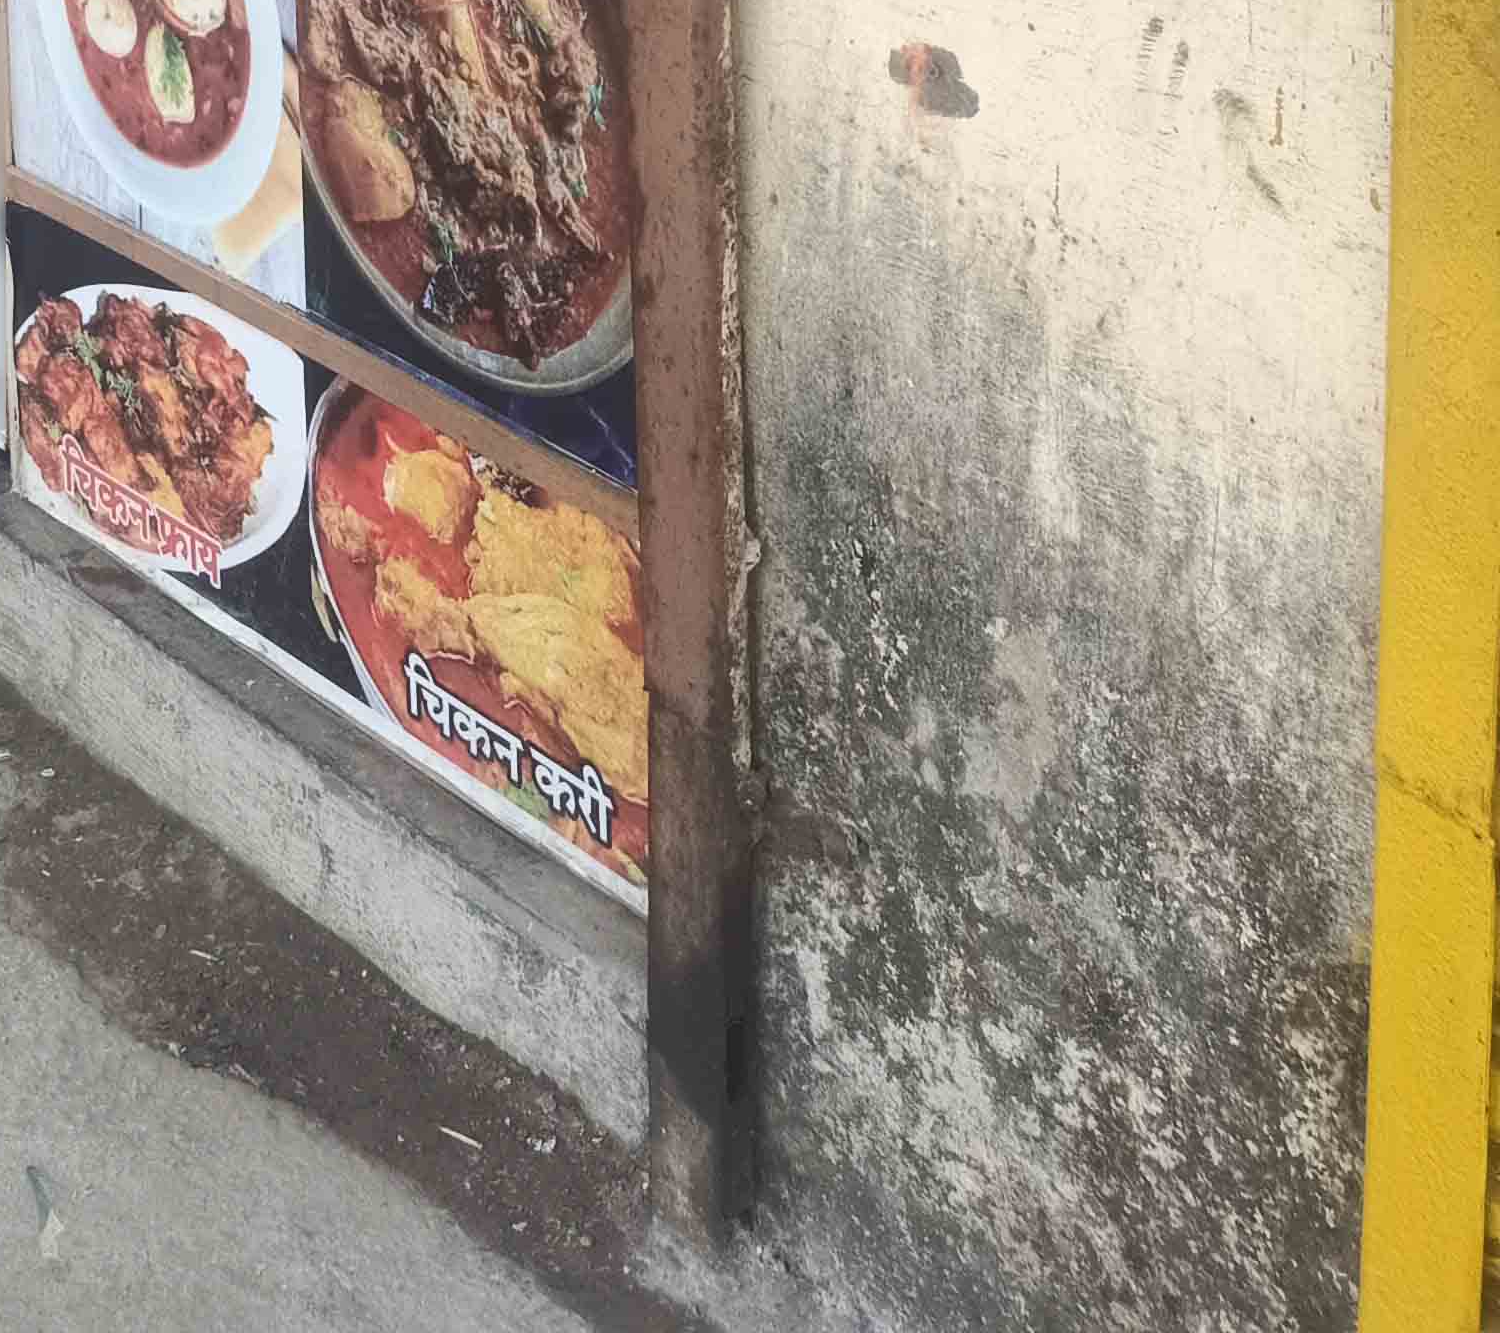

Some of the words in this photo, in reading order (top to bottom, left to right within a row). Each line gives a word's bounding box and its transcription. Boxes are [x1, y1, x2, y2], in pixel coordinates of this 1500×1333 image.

[59, 435, 155, 541] चिकन
[156, 505, 222, 589] फ्राय
[404, 654, 523, 786] चिकन
[524, 733, 616, 846] करी
